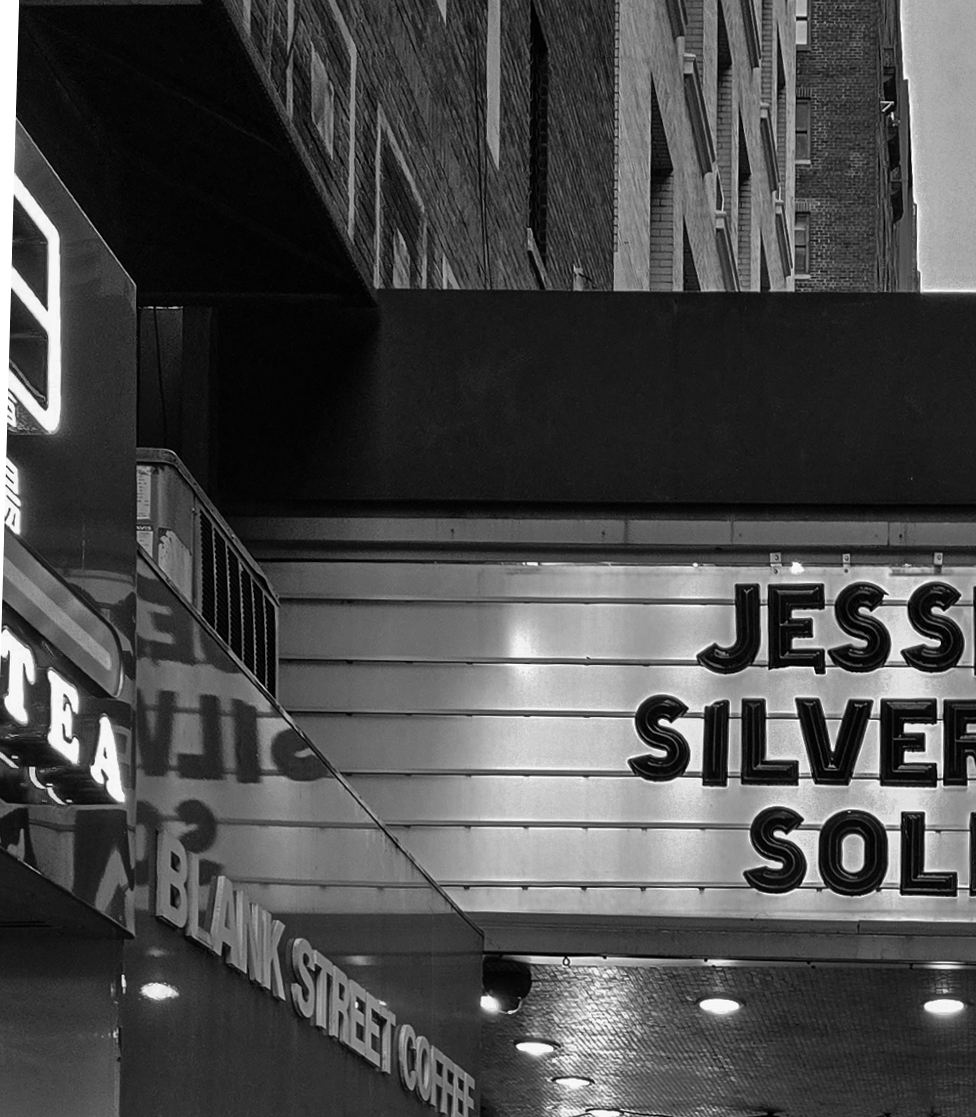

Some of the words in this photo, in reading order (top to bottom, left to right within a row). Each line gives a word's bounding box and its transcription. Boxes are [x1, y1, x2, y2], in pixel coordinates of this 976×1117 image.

[0, 625, 126, 803] TEA
[155, 828, 286, 1001] BLANK
[290, 937, 397, 1074] STREET
